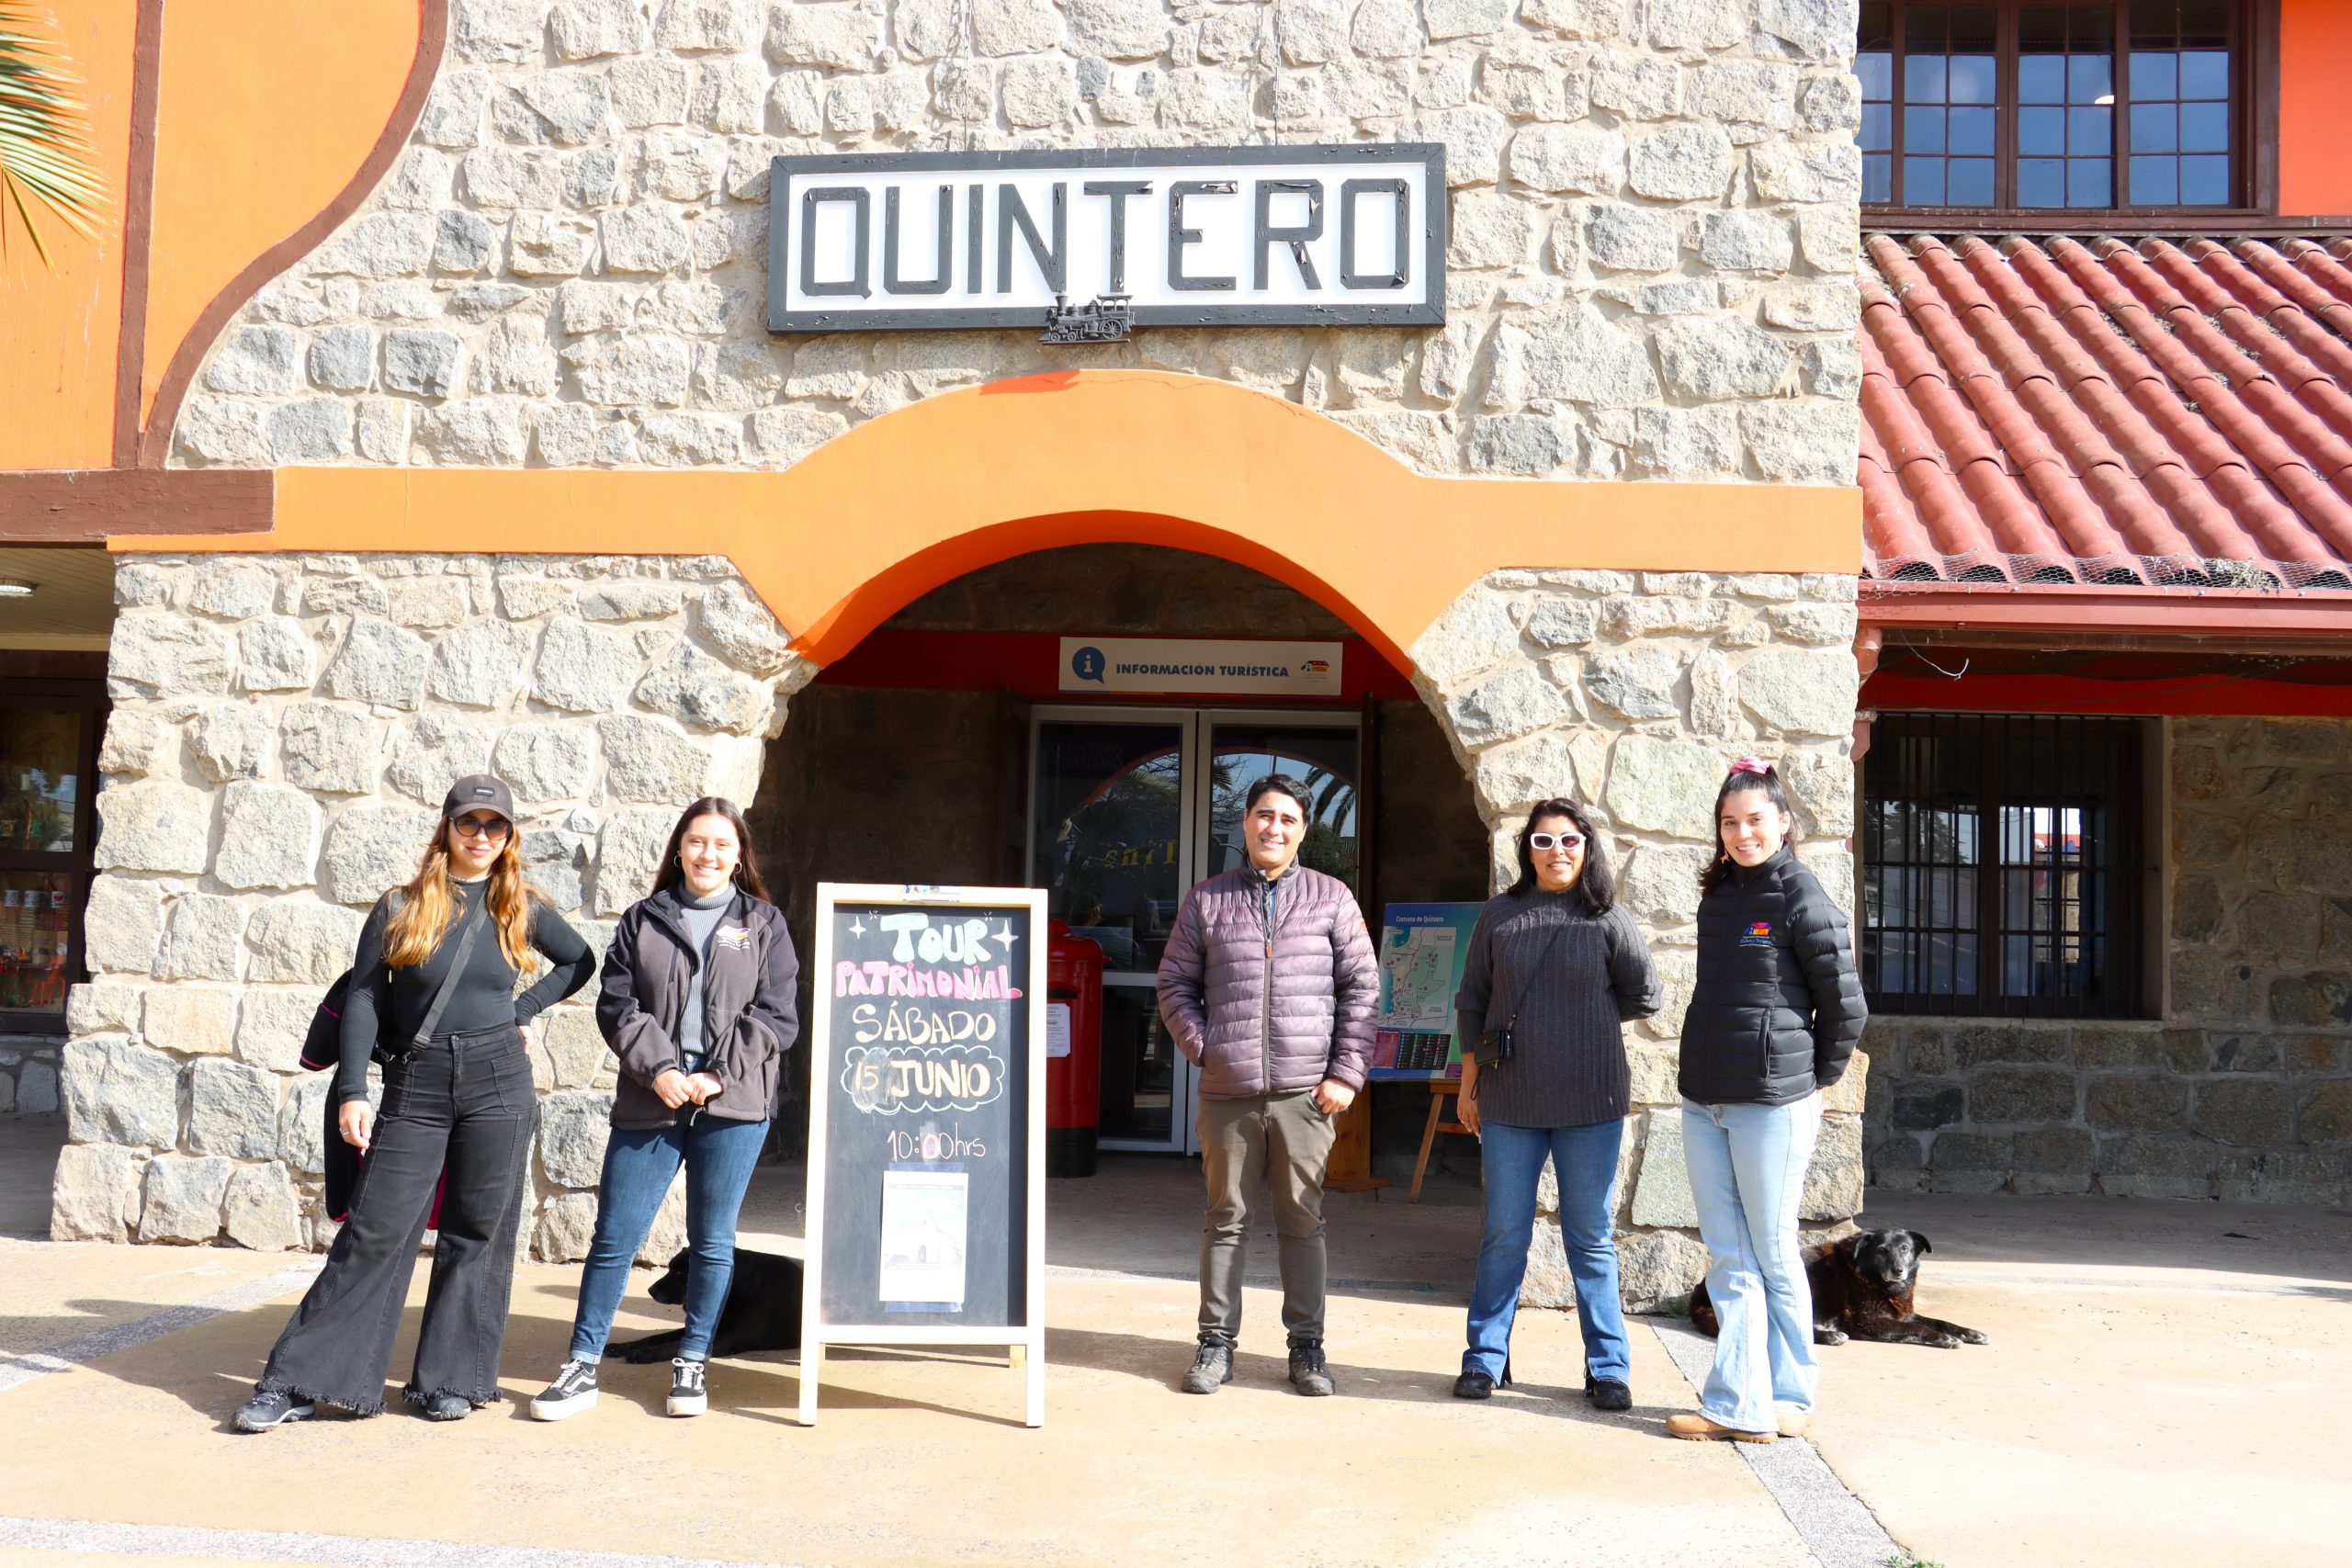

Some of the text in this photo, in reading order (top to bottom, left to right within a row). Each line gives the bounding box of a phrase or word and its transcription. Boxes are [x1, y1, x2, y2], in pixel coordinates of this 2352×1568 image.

[800, 177, 1410, 299] QUINTERO
[1116, 662, 1289, 677] INFORMACIÓN TURÍSTICA
[880, 913, 991, 965] TOUR
[853, 1000, 996, 1044] SÁBADO
[854, 1059, 990, 1098] 15 JUNIO
